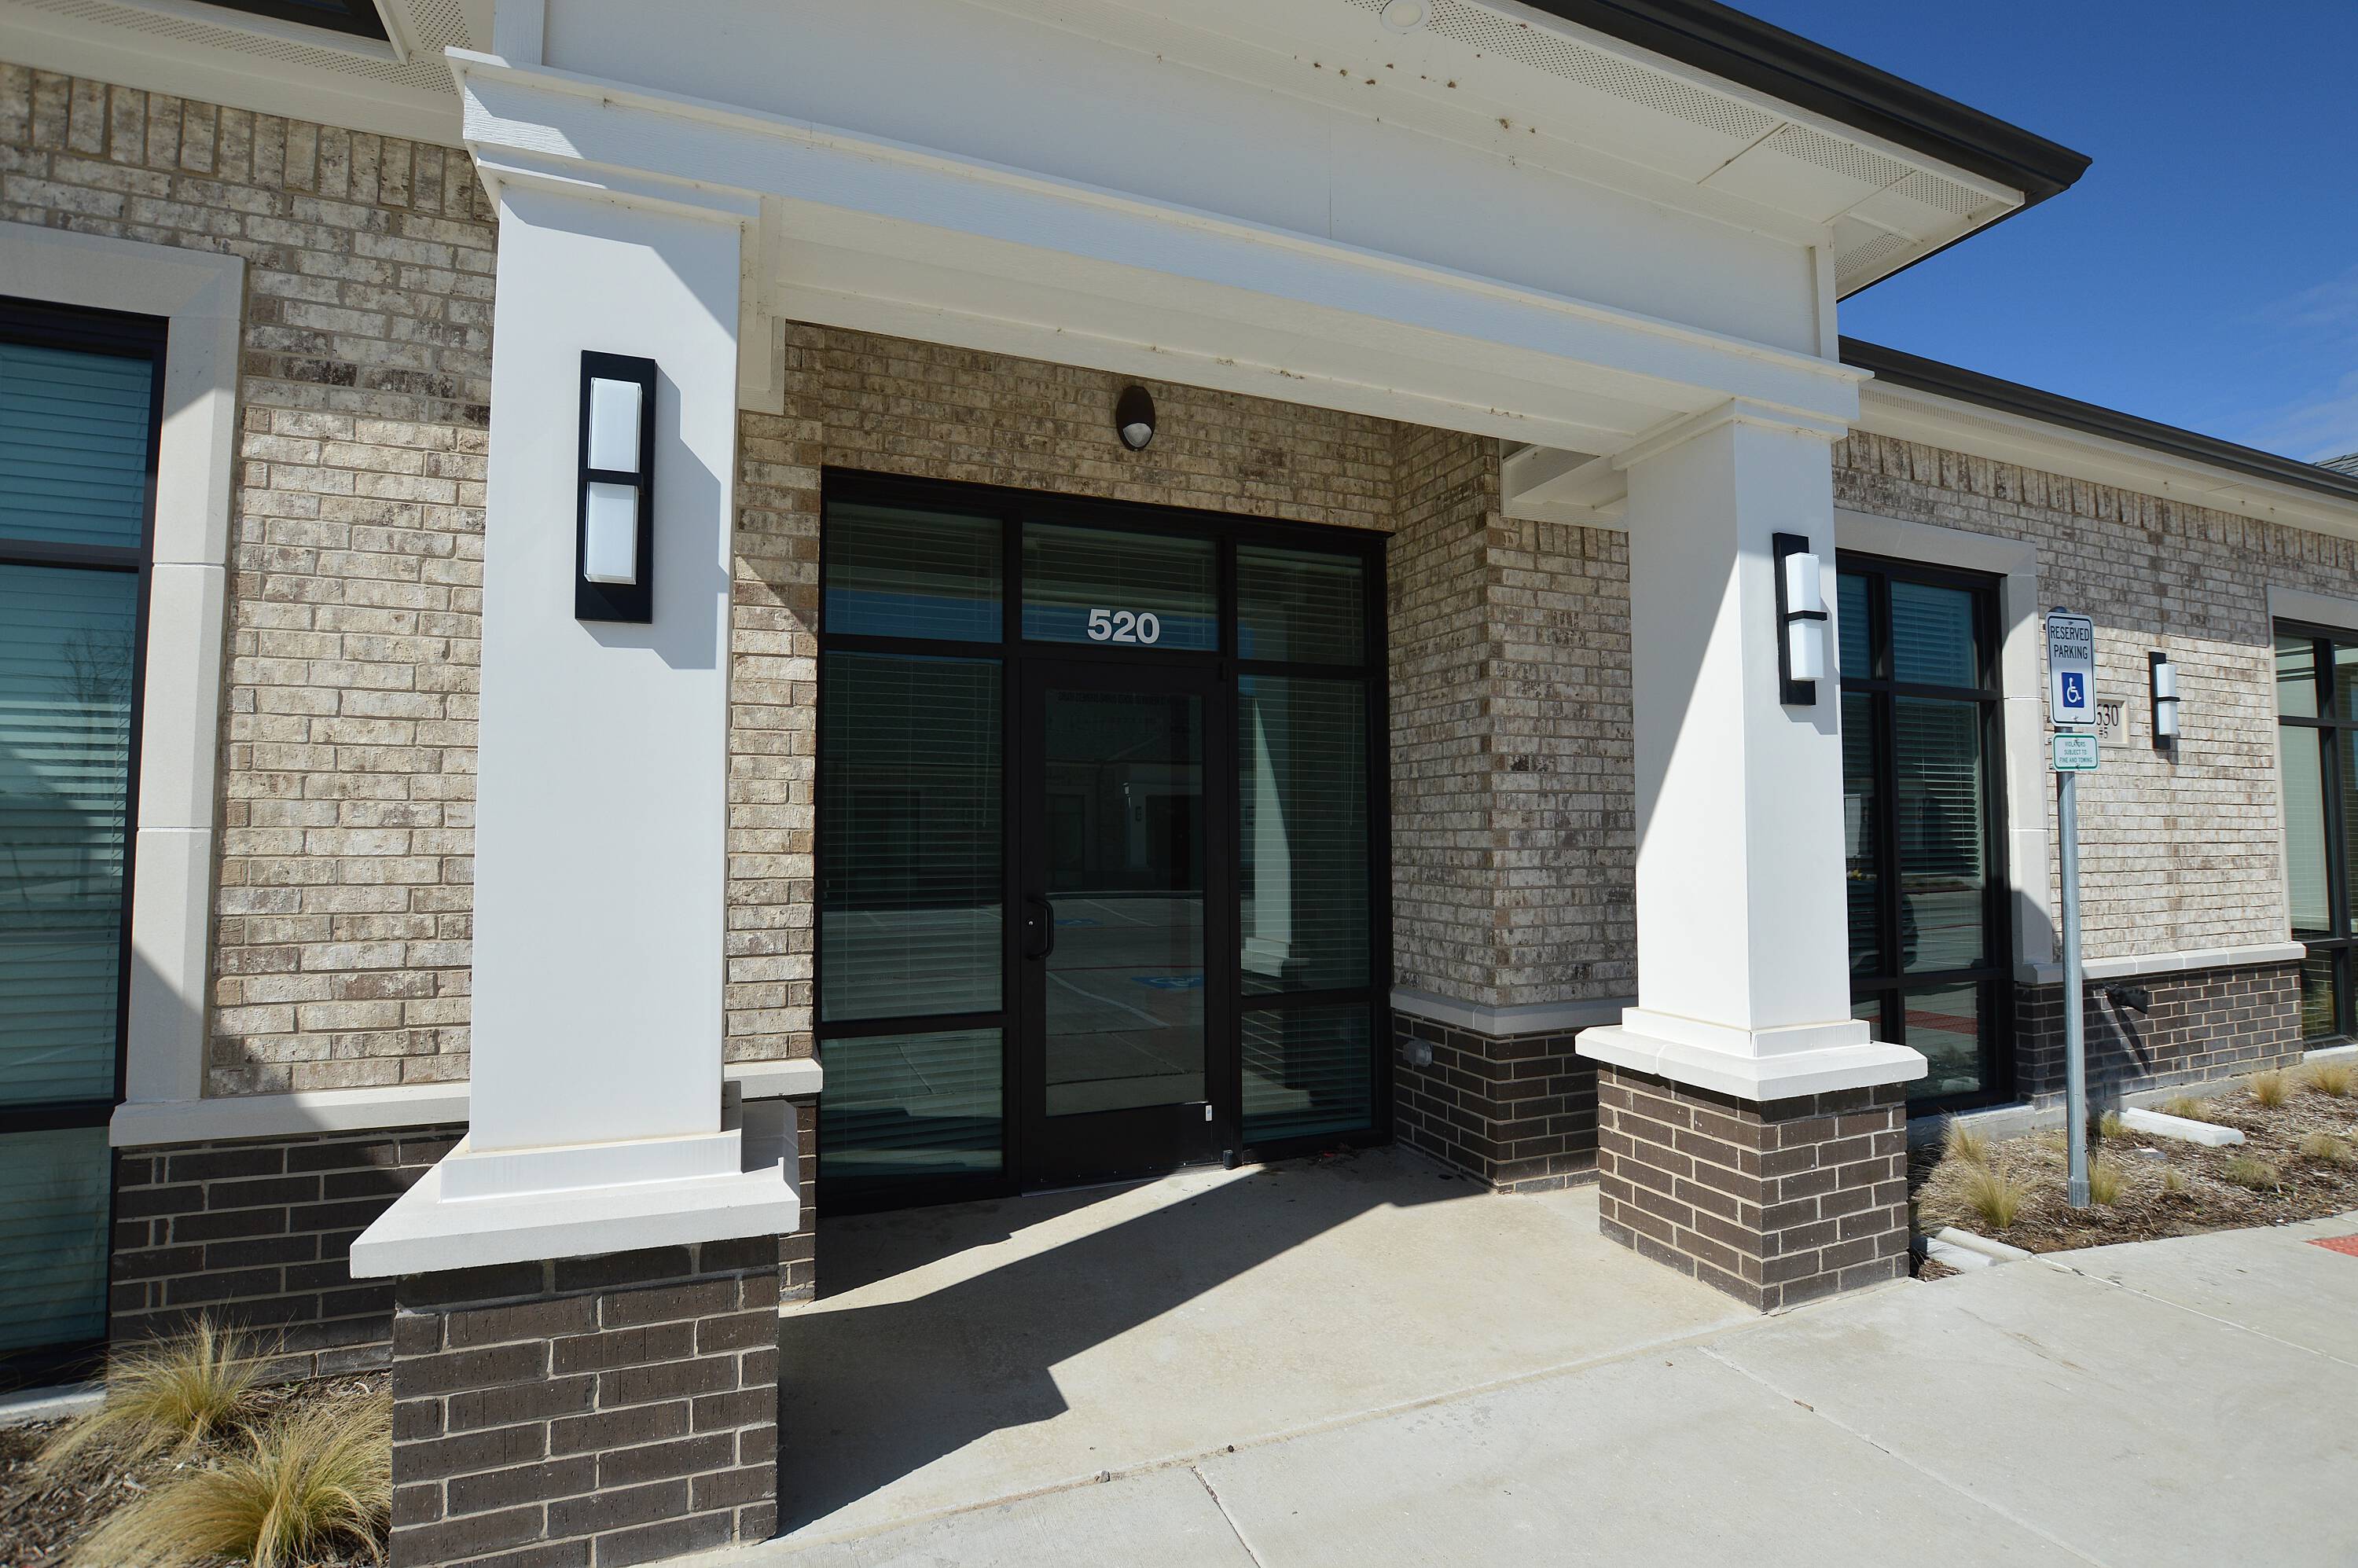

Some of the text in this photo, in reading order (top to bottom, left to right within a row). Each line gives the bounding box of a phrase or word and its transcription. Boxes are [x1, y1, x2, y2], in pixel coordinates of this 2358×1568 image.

[1087, 608, 1160, 644] 520
[2050, 625, 2090, 642] RESERVED
[2053, 644, 2088, 660] PARKING
